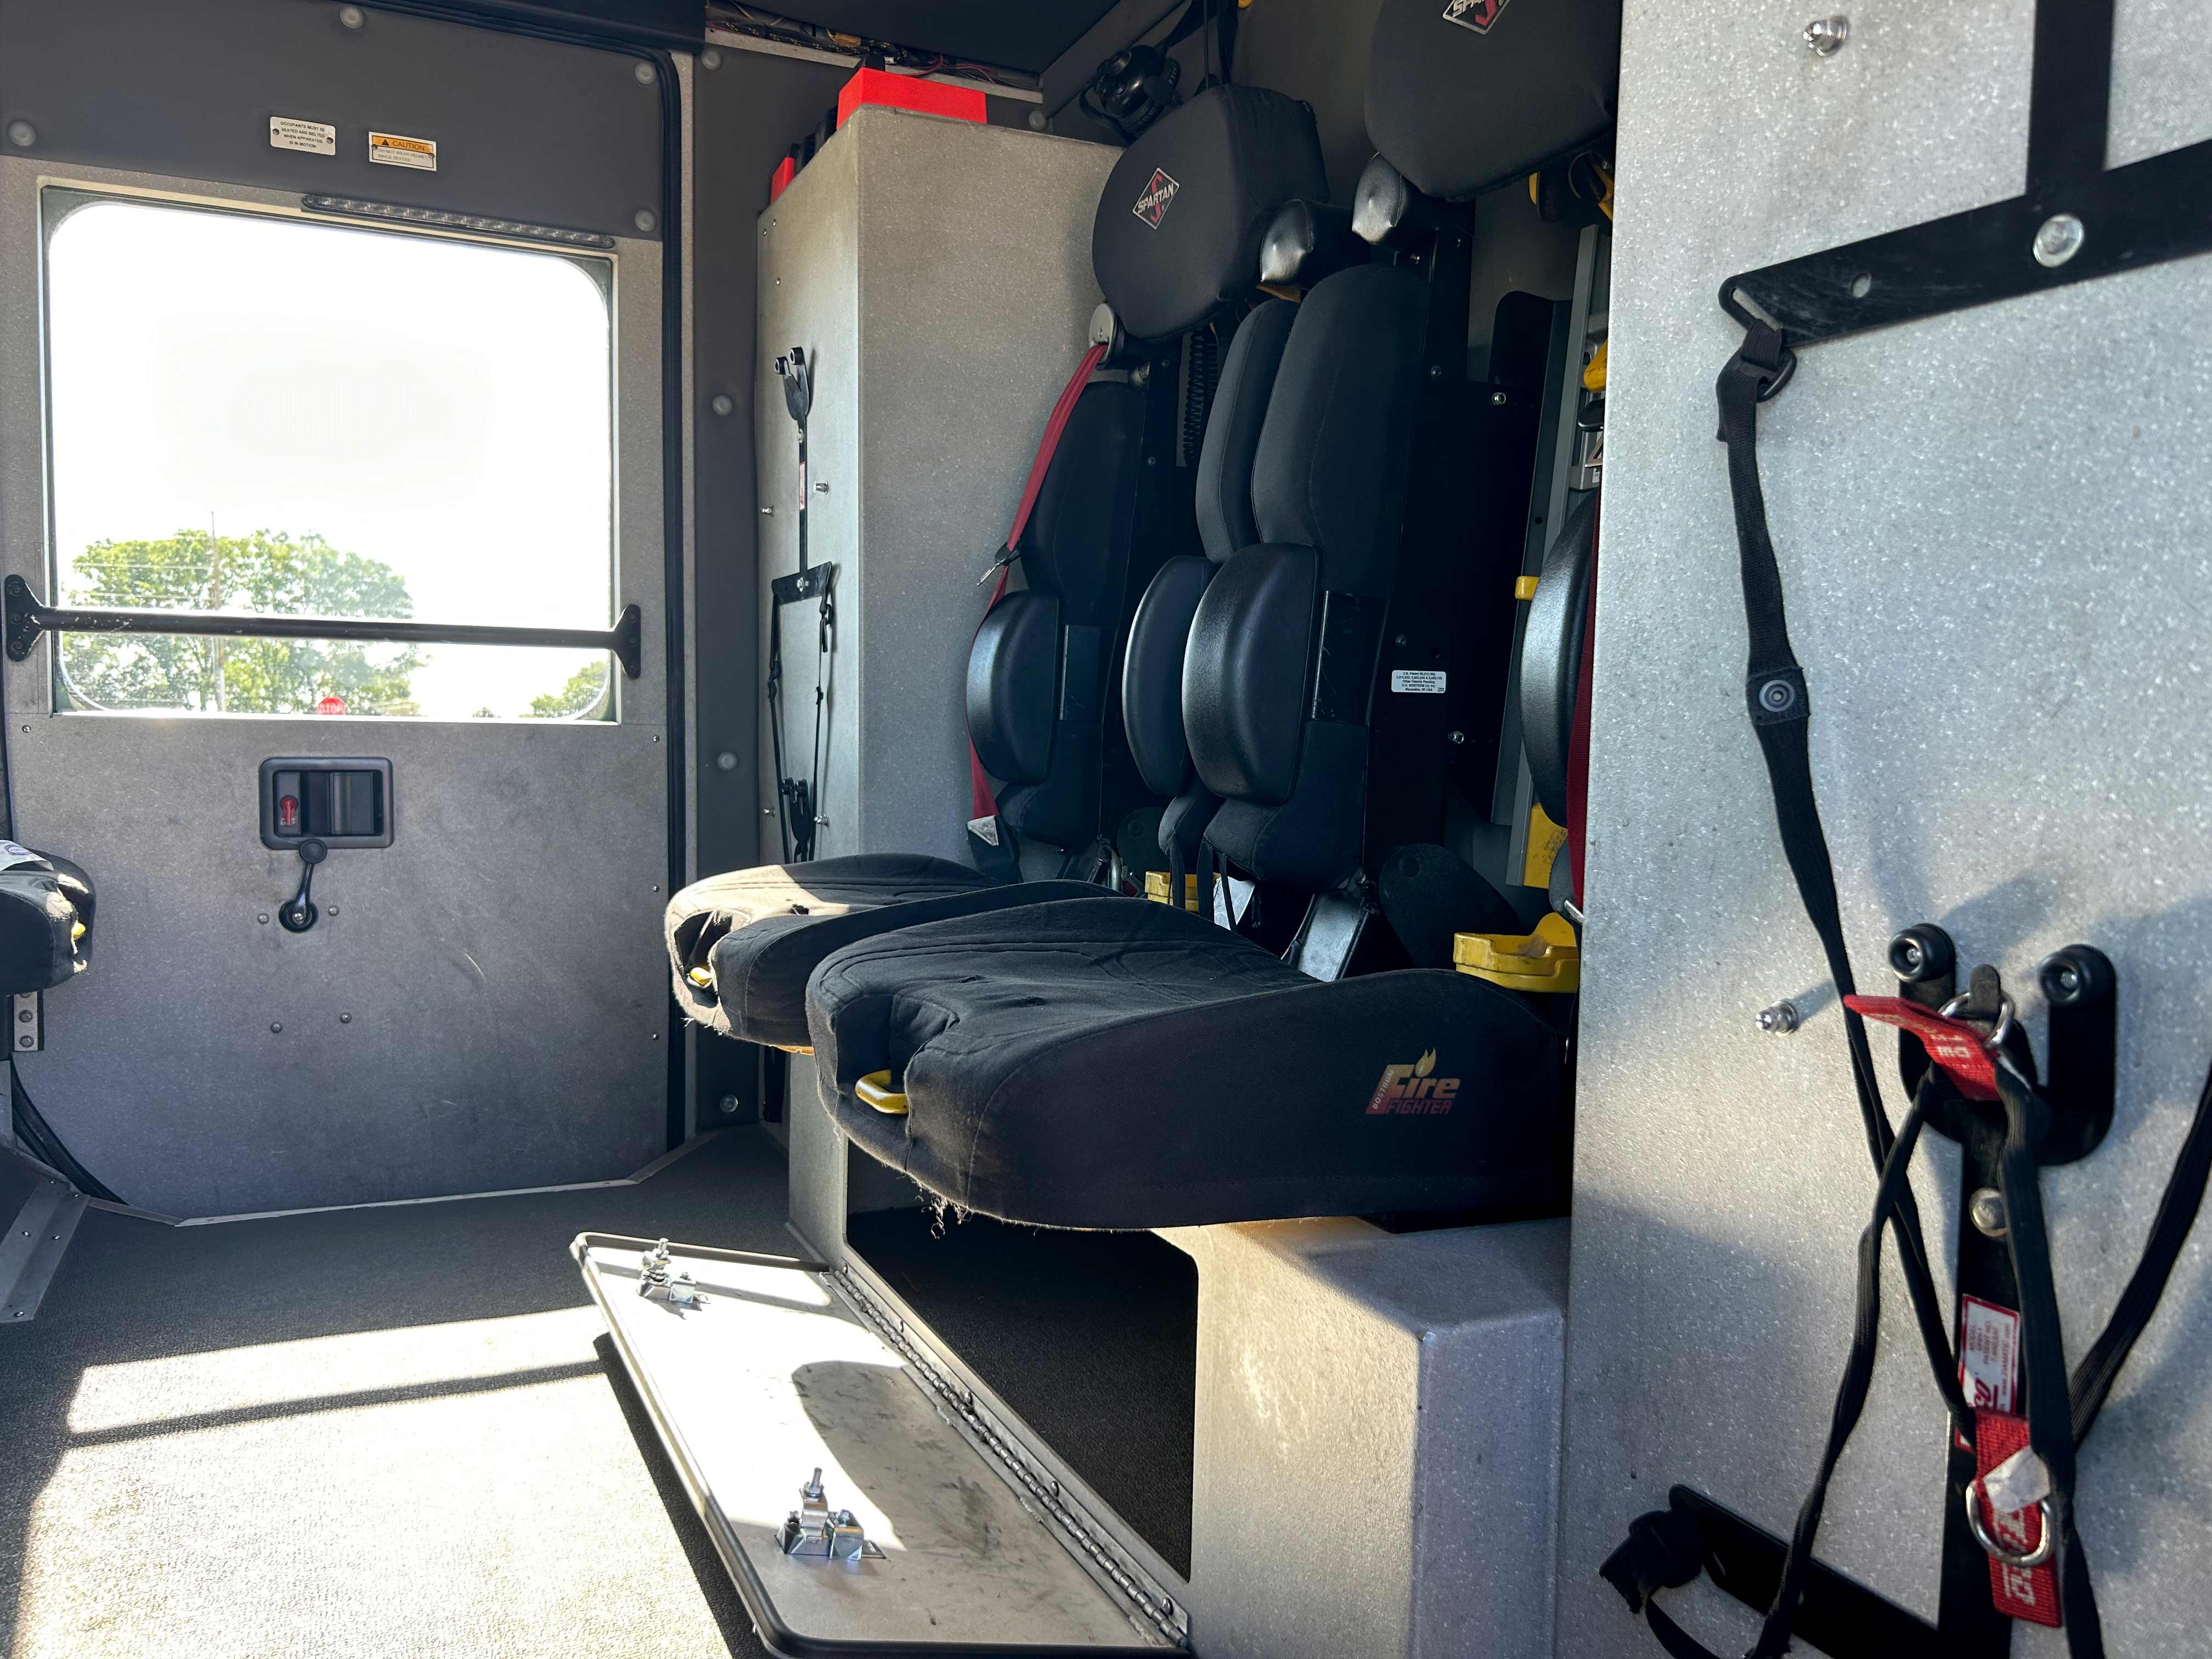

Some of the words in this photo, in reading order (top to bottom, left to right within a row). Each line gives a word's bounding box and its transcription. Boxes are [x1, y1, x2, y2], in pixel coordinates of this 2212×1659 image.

[392, 140, 425, 150] CAUTION
[1138, 183, 1173, 214] SPARTAN
[319, 702, 343, 714] STOP
[1365, 1063, 1461, 1114] Fire
[1372, 1069, 1395, 1110] BOSTROM
[1387, 1098, 1453, 1115] FIGHTER
